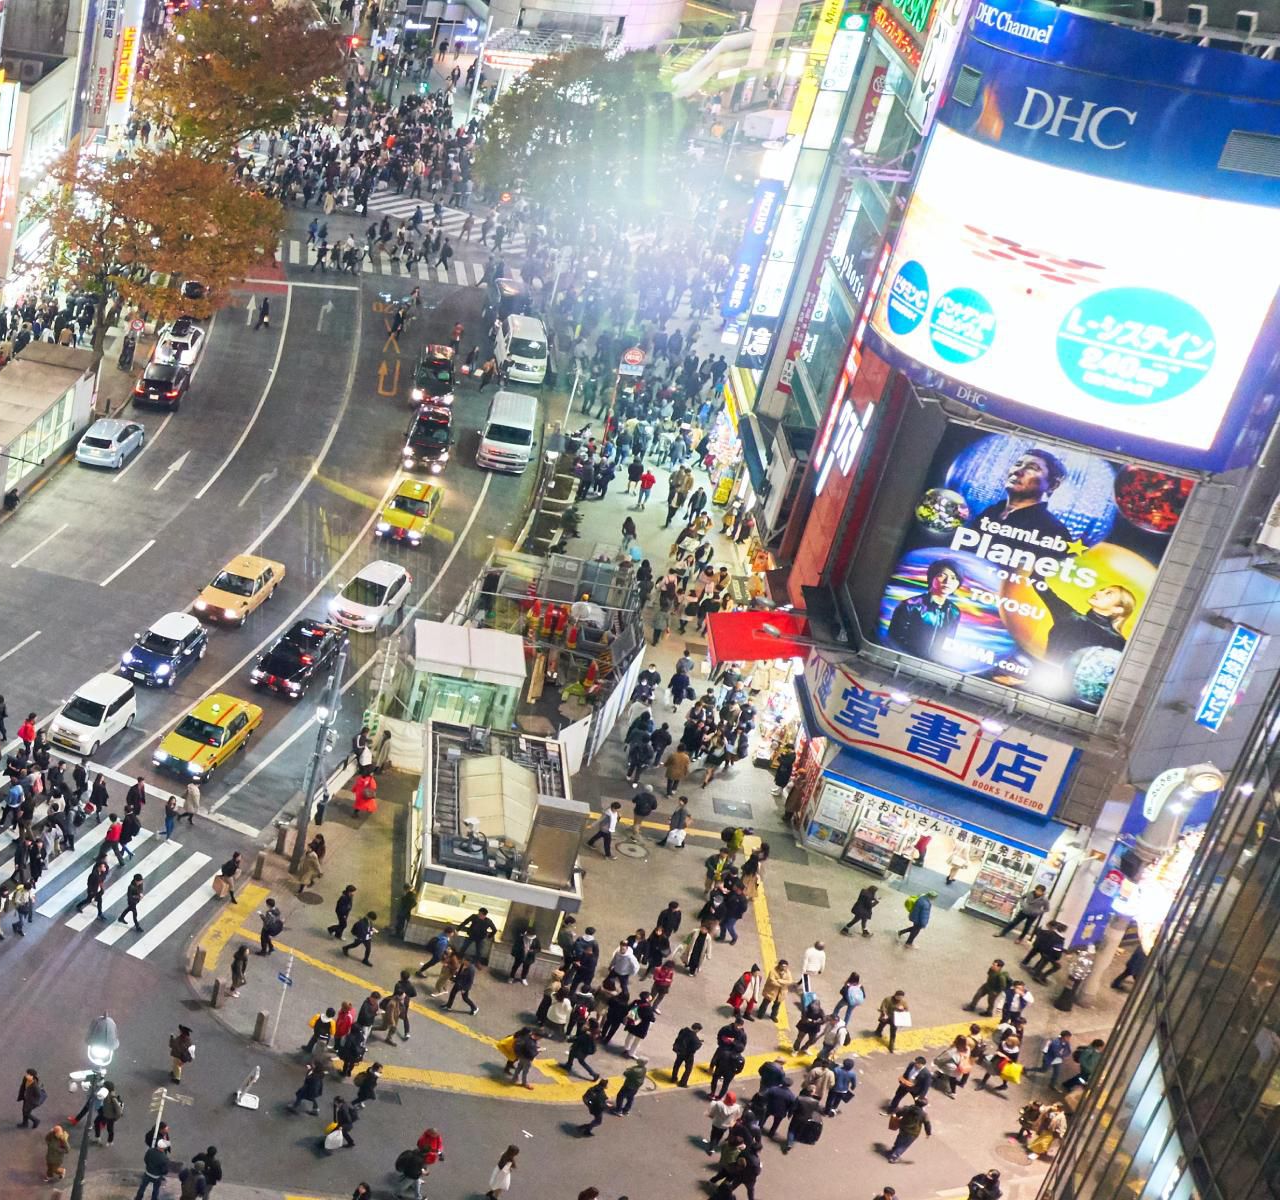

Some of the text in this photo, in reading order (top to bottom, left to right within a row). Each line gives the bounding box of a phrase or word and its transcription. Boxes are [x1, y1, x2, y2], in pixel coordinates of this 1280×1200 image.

[975, 2, 1054, 44] DHC Channel
[1014, 87, 1138, 149] DHC
[1066, 306, 1215, 360] L-システイン
[956, 386, 988, 407] DHC
[980, 516, 1068, 552] teamLab
[950, 526, 1098, 589] Planets
[987, 567, 1049, 592] TOKYO
[969, 587, 1046, 621] TOYOSU
[942, 637, 1030, 676] DMM.com
[971, 779, 1045, 811] BOOKS TAISEIDO
[901, 801, 964, 828] TAISEIDO
